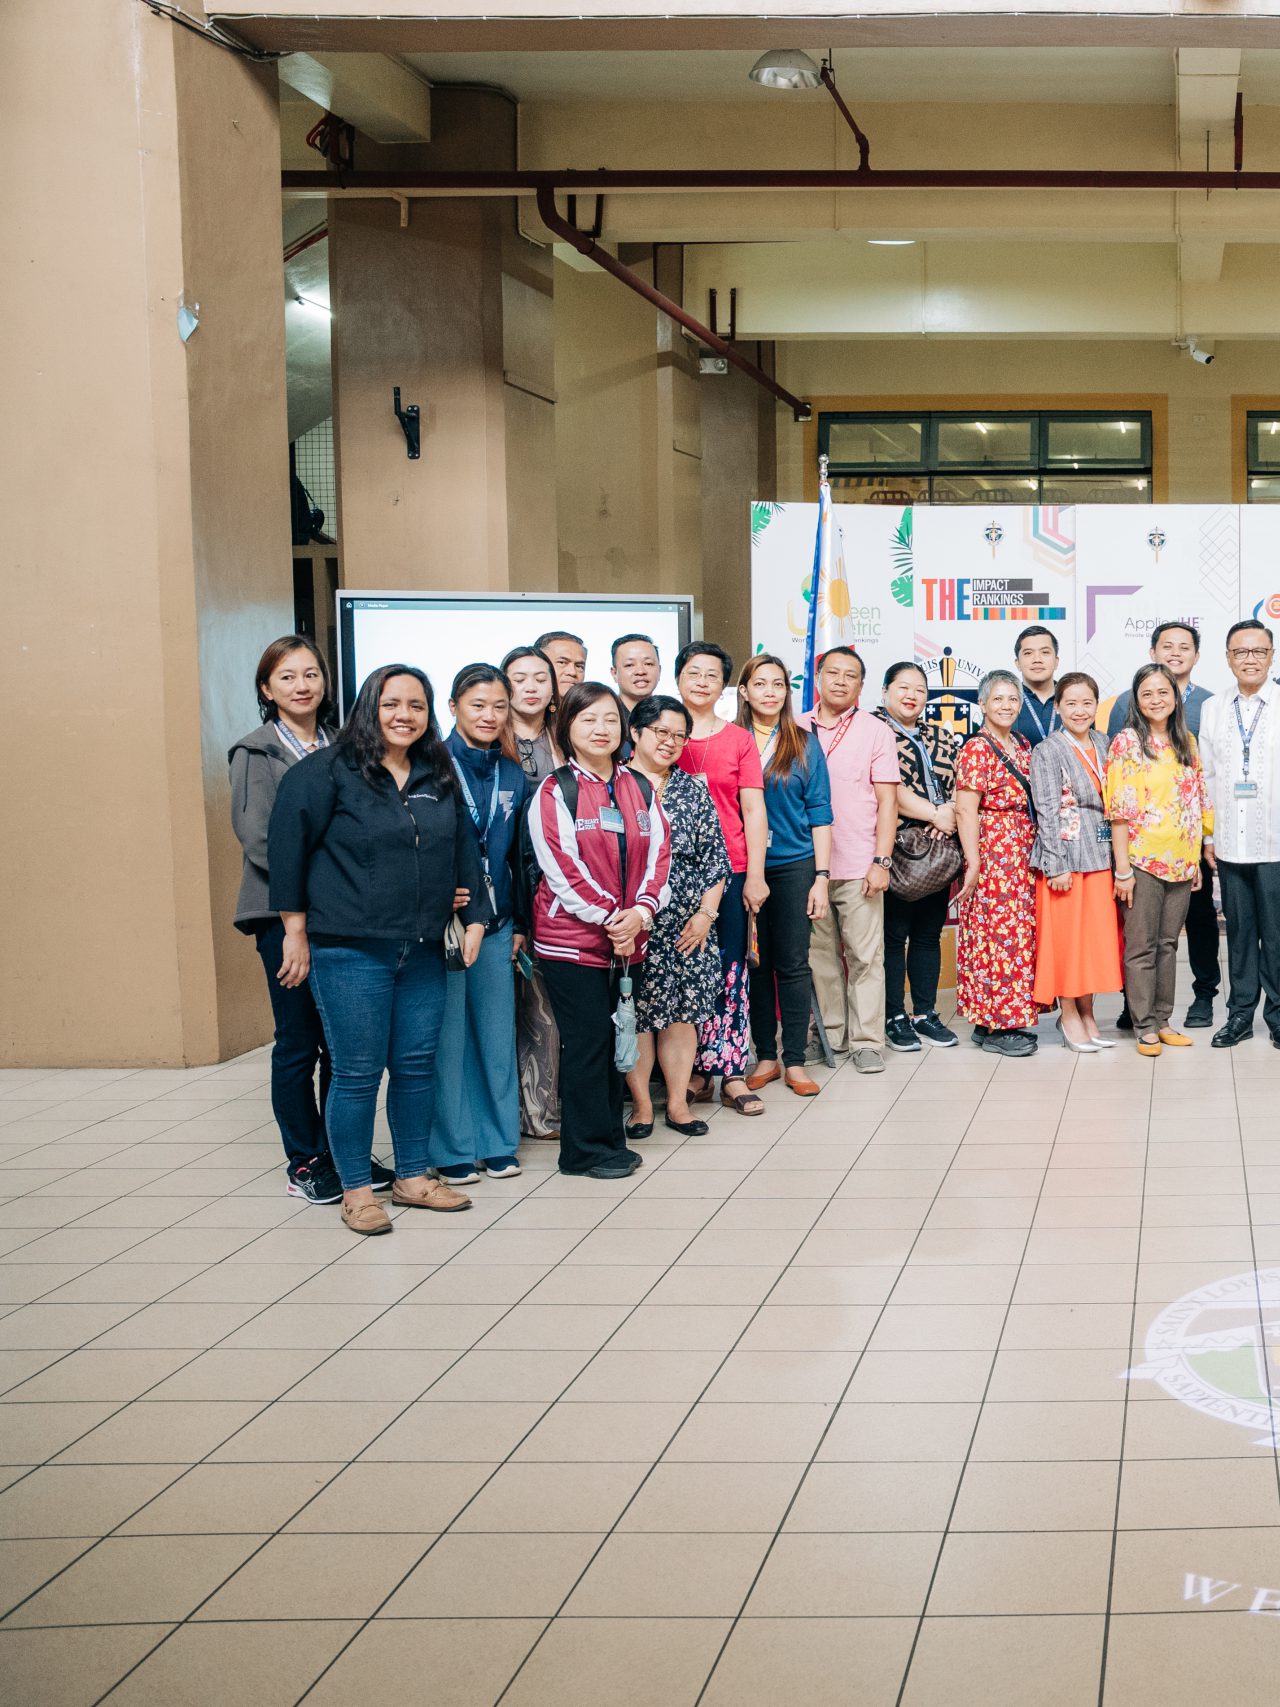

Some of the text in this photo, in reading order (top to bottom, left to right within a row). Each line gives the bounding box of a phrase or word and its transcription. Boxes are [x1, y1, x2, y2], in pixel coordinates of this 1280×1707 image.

[973, 579, 1009, 591] IMPACT
[922, 578, 971, 621] THE
[973, 593, 1024, 605] RANKINGS
[1156, 1298, 1203, 1337] SAINT
